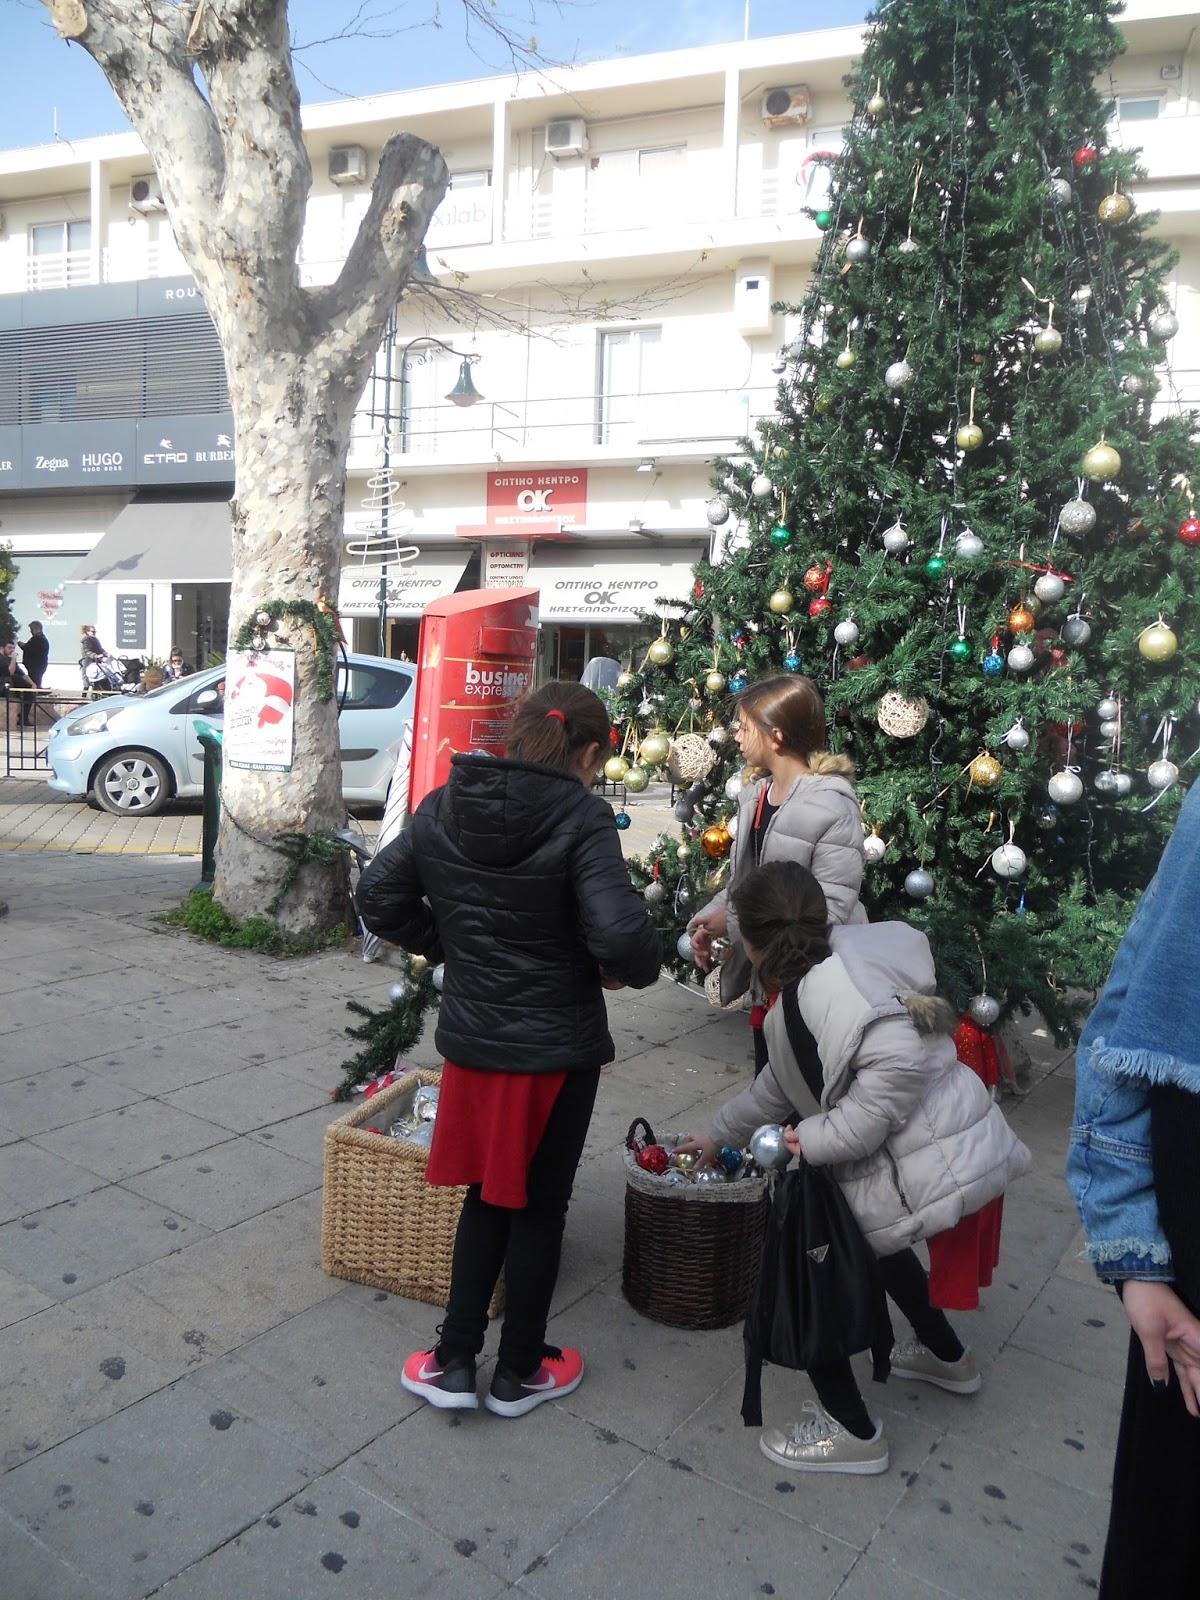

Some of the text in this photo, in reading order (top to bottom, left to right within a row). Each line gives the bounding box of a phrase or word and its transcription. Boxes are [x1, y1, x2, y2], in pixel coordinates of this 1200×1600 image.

[35, 455, 69, 472] Zegna
[82, 452, 123, 466] HUGO
[494, 475, 579, 486] ΟΠΤΙΚΟ ΚΕΝΤΡΟ
[396, 579, 442, 588] ΚΕΝΤΡΟ
[554, 580, 659, 590] ΟΠΤΙΚΟ ΚΕΝΤΡΟ
[464, 684, 512, 700] express
